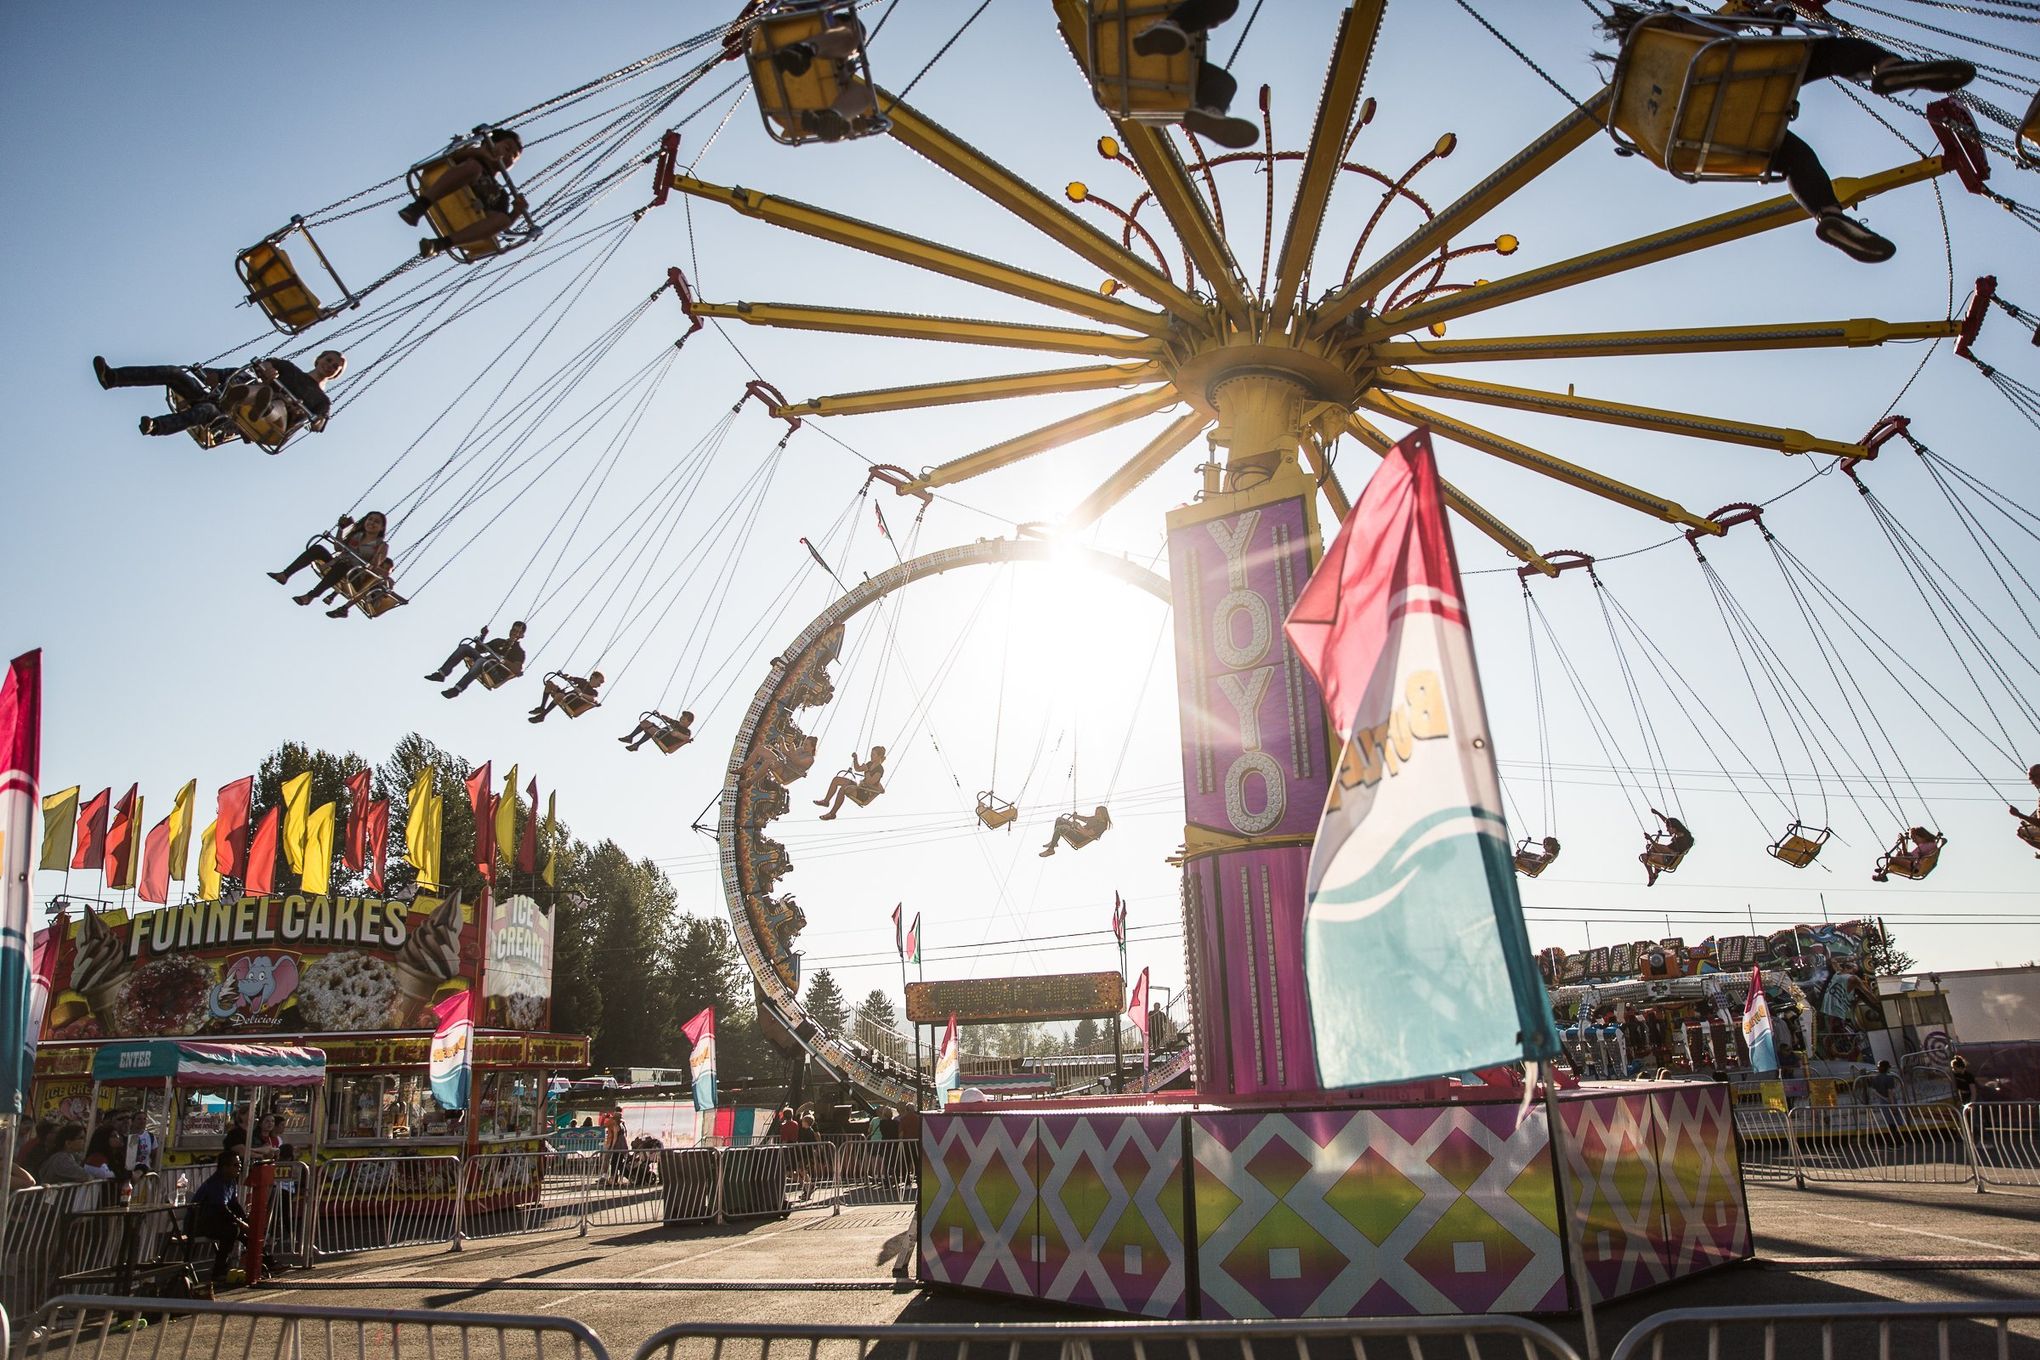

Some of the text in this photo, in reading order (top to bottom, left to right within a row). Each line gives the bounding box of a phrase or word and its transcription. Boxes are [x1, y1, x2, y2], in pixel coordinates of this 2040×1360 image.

[513, 894, 534, 928] ICE
[128, 895, 408, 957] FUNNEL CAKES
[496, 926, 545, 968] CREAM
[229, 1012, 283, 1027] Delicious
[120, 1051, 152, 1068] ENTER
[45, 1086, 66, 1099] ICE
